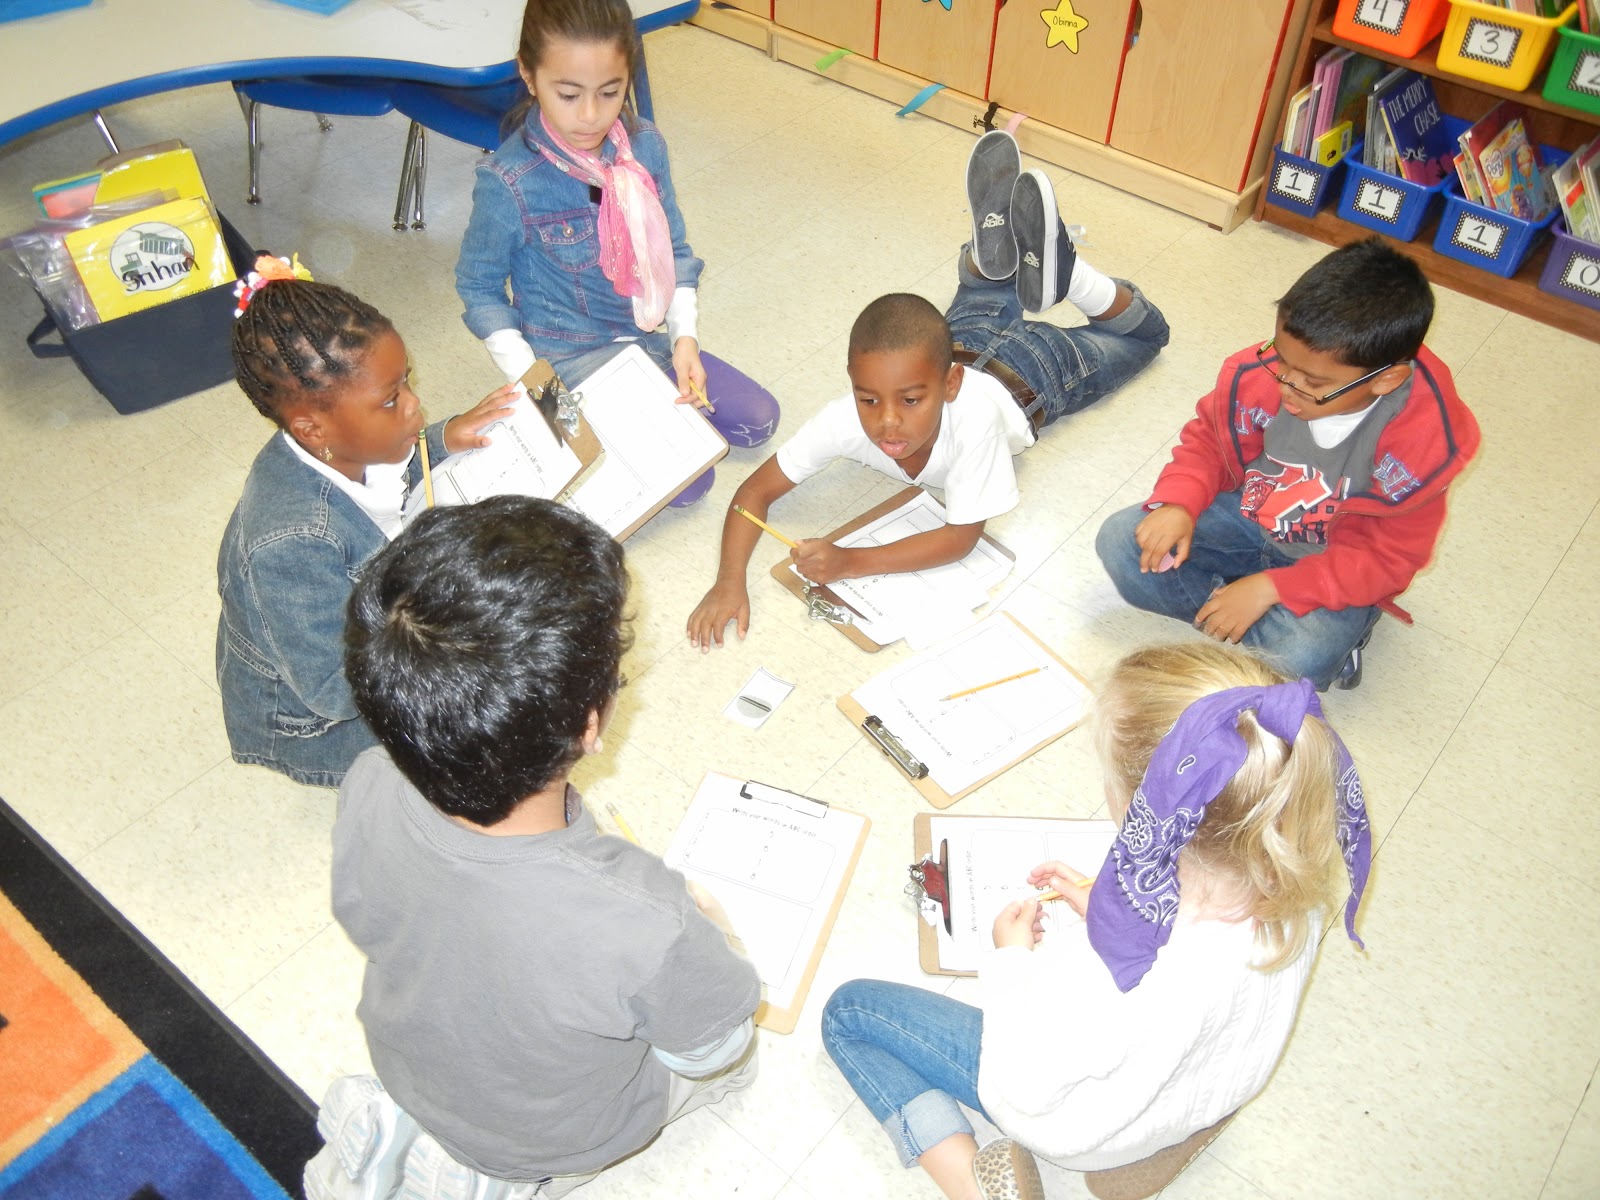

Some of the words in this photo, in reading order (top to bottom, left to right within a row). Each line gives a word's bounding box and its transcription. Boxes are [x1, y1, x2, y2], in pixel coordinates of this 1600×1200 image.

[1053, 16, 1078, 28] Obinna
[1373, 0, 1389, 22] 4
[1480, 30, 1500, 54] 3
[1387, 95, 1405, 123] THE
[1402, 80, 1427, 112] MERRY
[1414, 101, 1440, 135] CHASE
[1285, 172, 1301, 191] 1
[1368, 188, 1386, 210] 1
[982, 218, 1005, 229] ADIO
[1467, 225, 1487, 246] 1
[122, 257, 200, 292] Srihan
[788, 824, 801, 832] ABC
